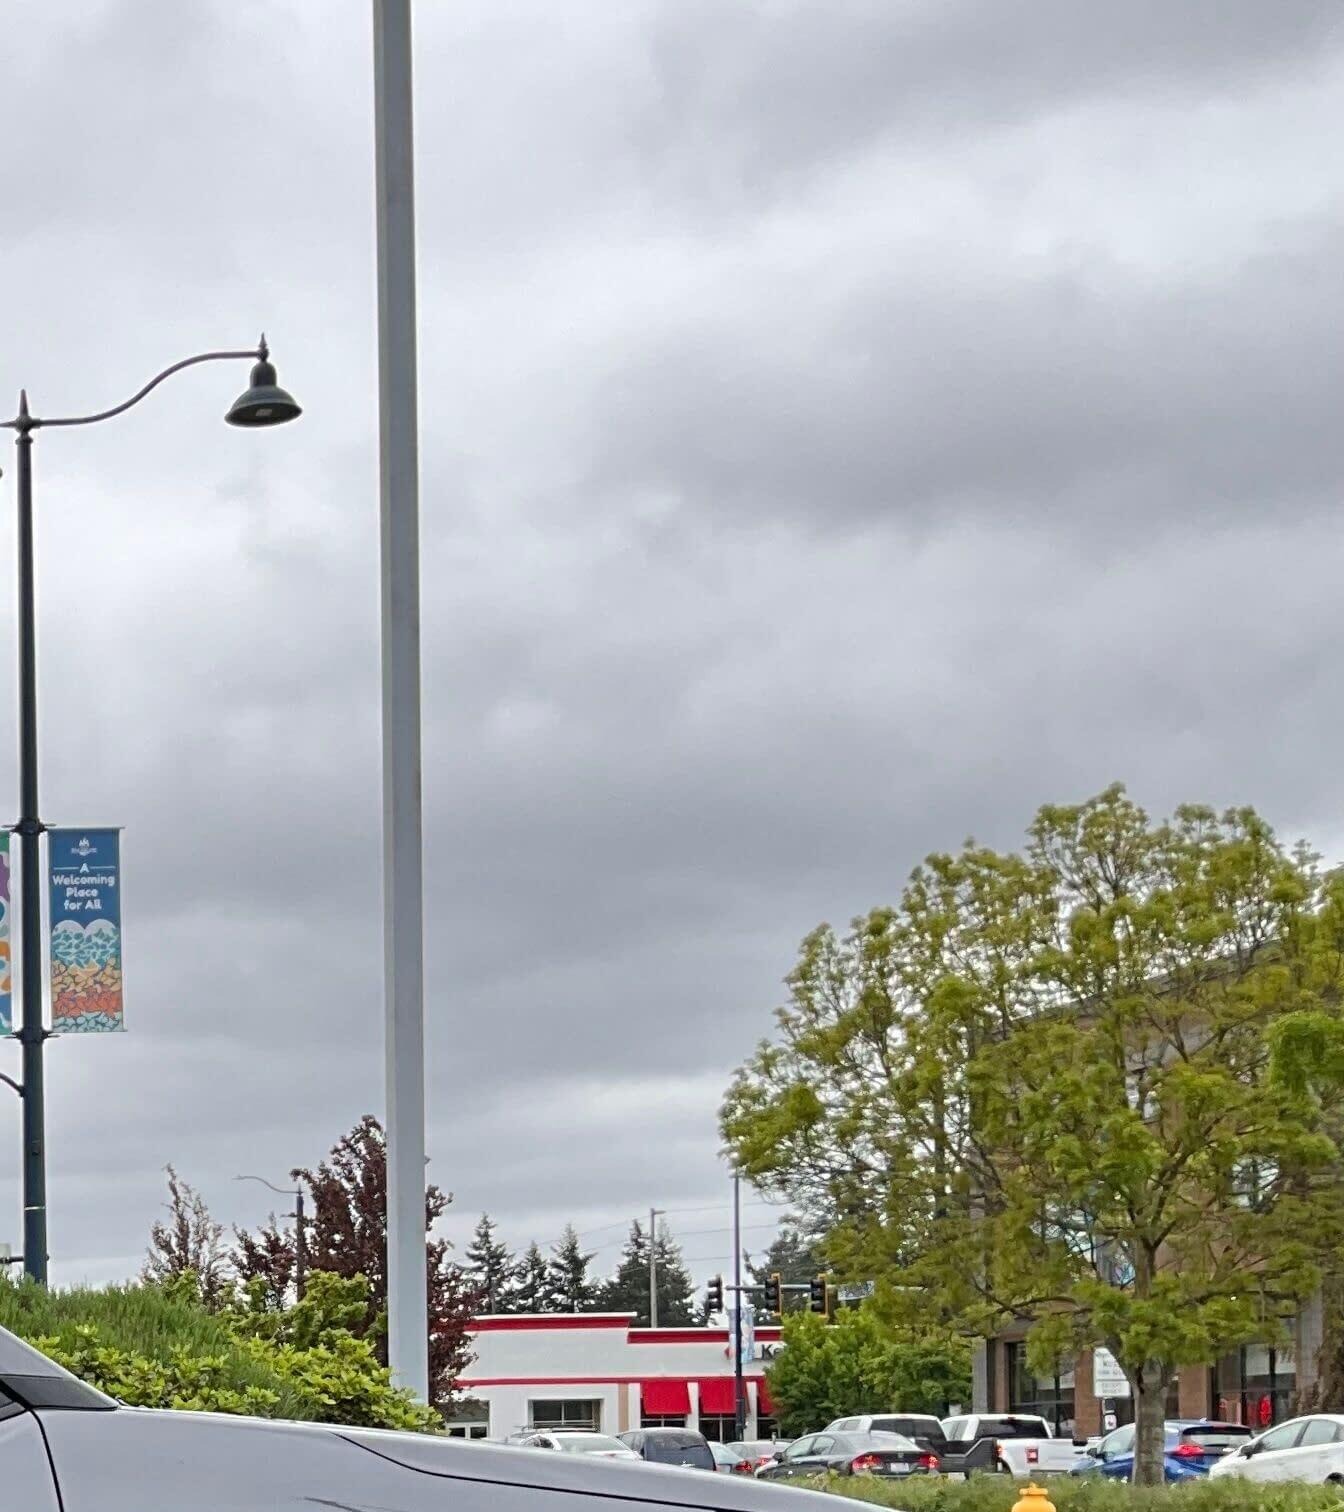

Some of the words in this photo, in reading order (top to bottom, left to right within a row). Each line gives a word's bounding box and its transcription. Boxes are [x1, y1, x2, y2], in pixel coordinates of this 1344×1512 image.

[79, 863, 90, 873] A
[52, 874, 116, 887] Welcoming
[66, 887, 99, 898] Place
[63, 899, 82, 910] for
[85, 899, 102, 910] All
